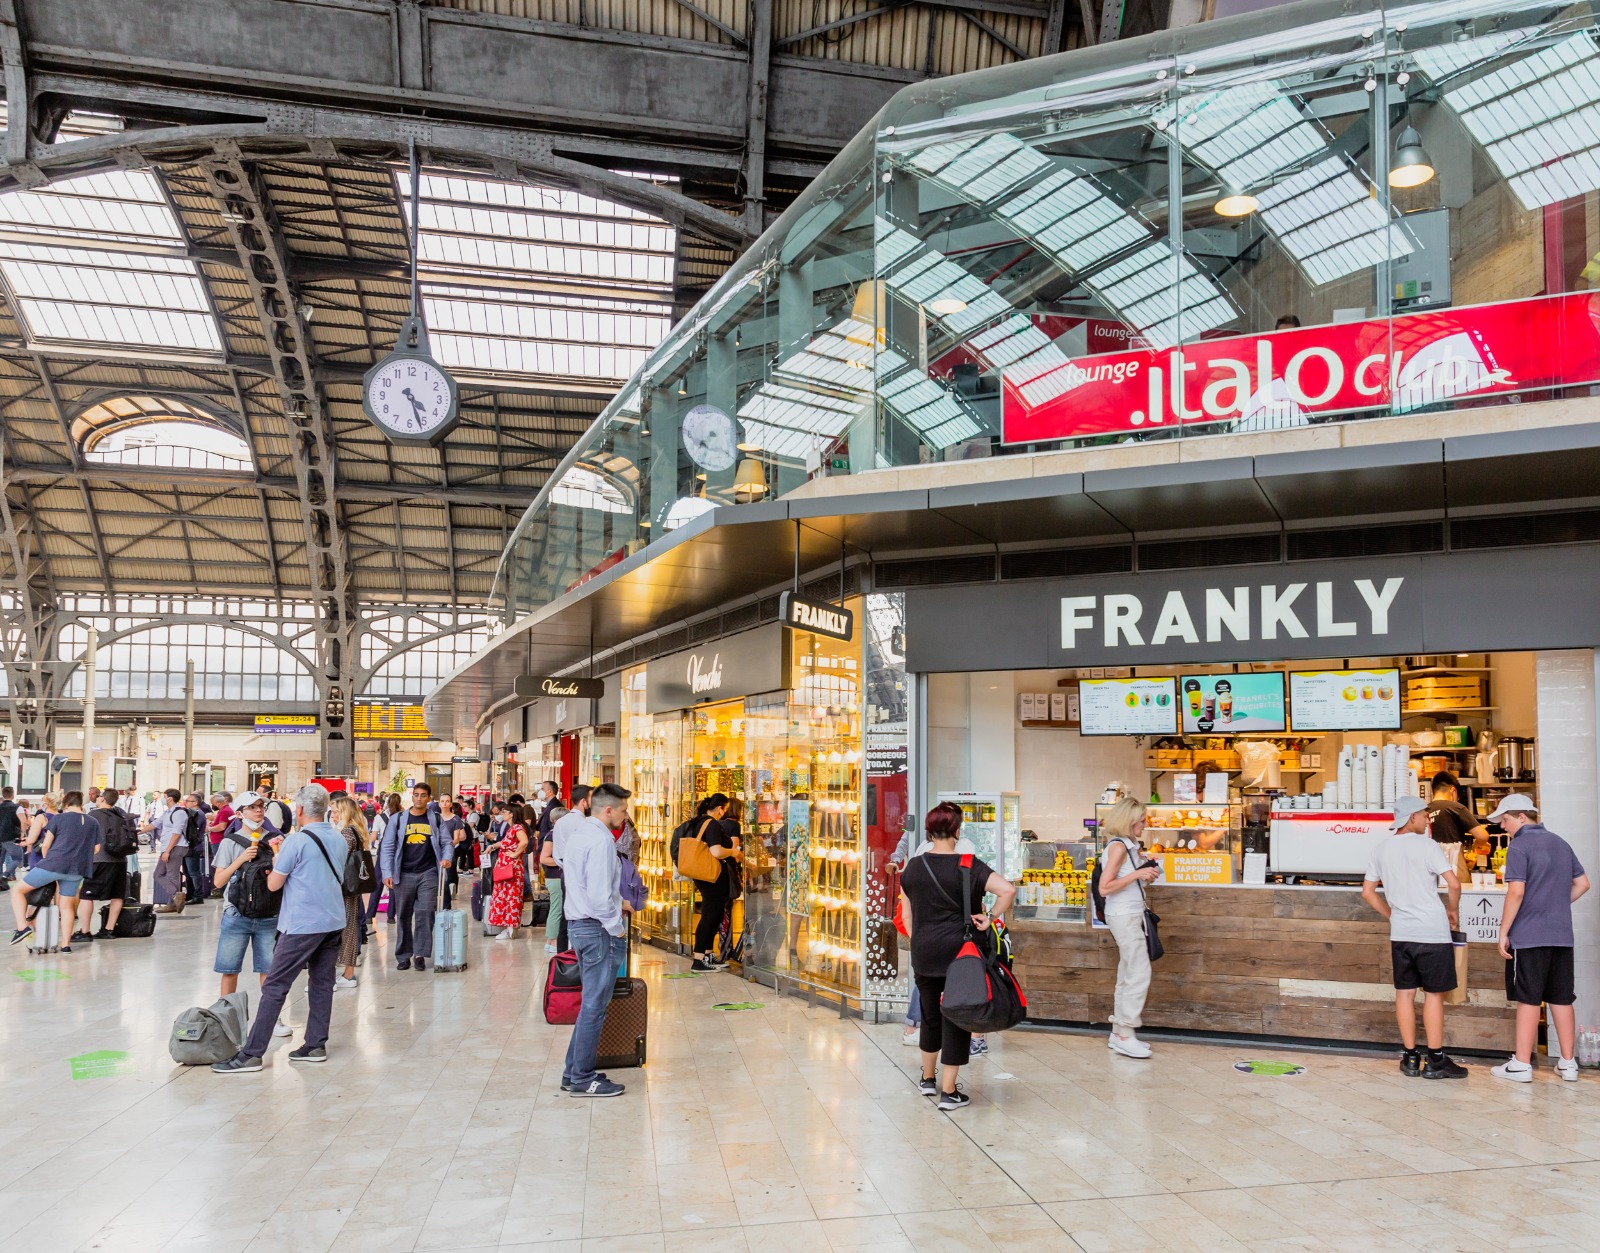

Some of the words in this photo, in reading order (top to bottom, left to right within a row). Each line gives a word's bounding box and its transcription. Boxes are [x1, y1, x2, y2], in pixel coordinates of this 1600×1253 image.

[1094, 325, 1132, 341] lounge
[394, 369, 401, 379] 11
[407, 366, 416, 376] 12
[424, 371, 428, 380] 1
[1067, 361, 1139, 384] lounge
[382, 378, 391, 387] 10
[433, 381, 439, 391] 2
[379, 391, 385, 400] 9
[436, 395, 442, 405] 3
[383, 404, 389, 414] 8
[432, 408, 438, 417] 4
[393, 414, 399, 424] 7
[407, 419, 413, 428] 6
[421, 416, 427, 426] 5
[793, 601, 848, 635] FRANKLY
[1061, 577, 1404, 649] FRANKLY
[687, 653, 722, 694] Venchi
[541, 679, 579, 695] Venchi
[1174, 857, 1212, 865] FRANKLY
[1174, 865, 1222, 873] HAPPINESS
[1185, 873, 1192, 881] A
[1467, 916, 1501, 927] RITIR
[1477, 929, 1497, 939] QUI
